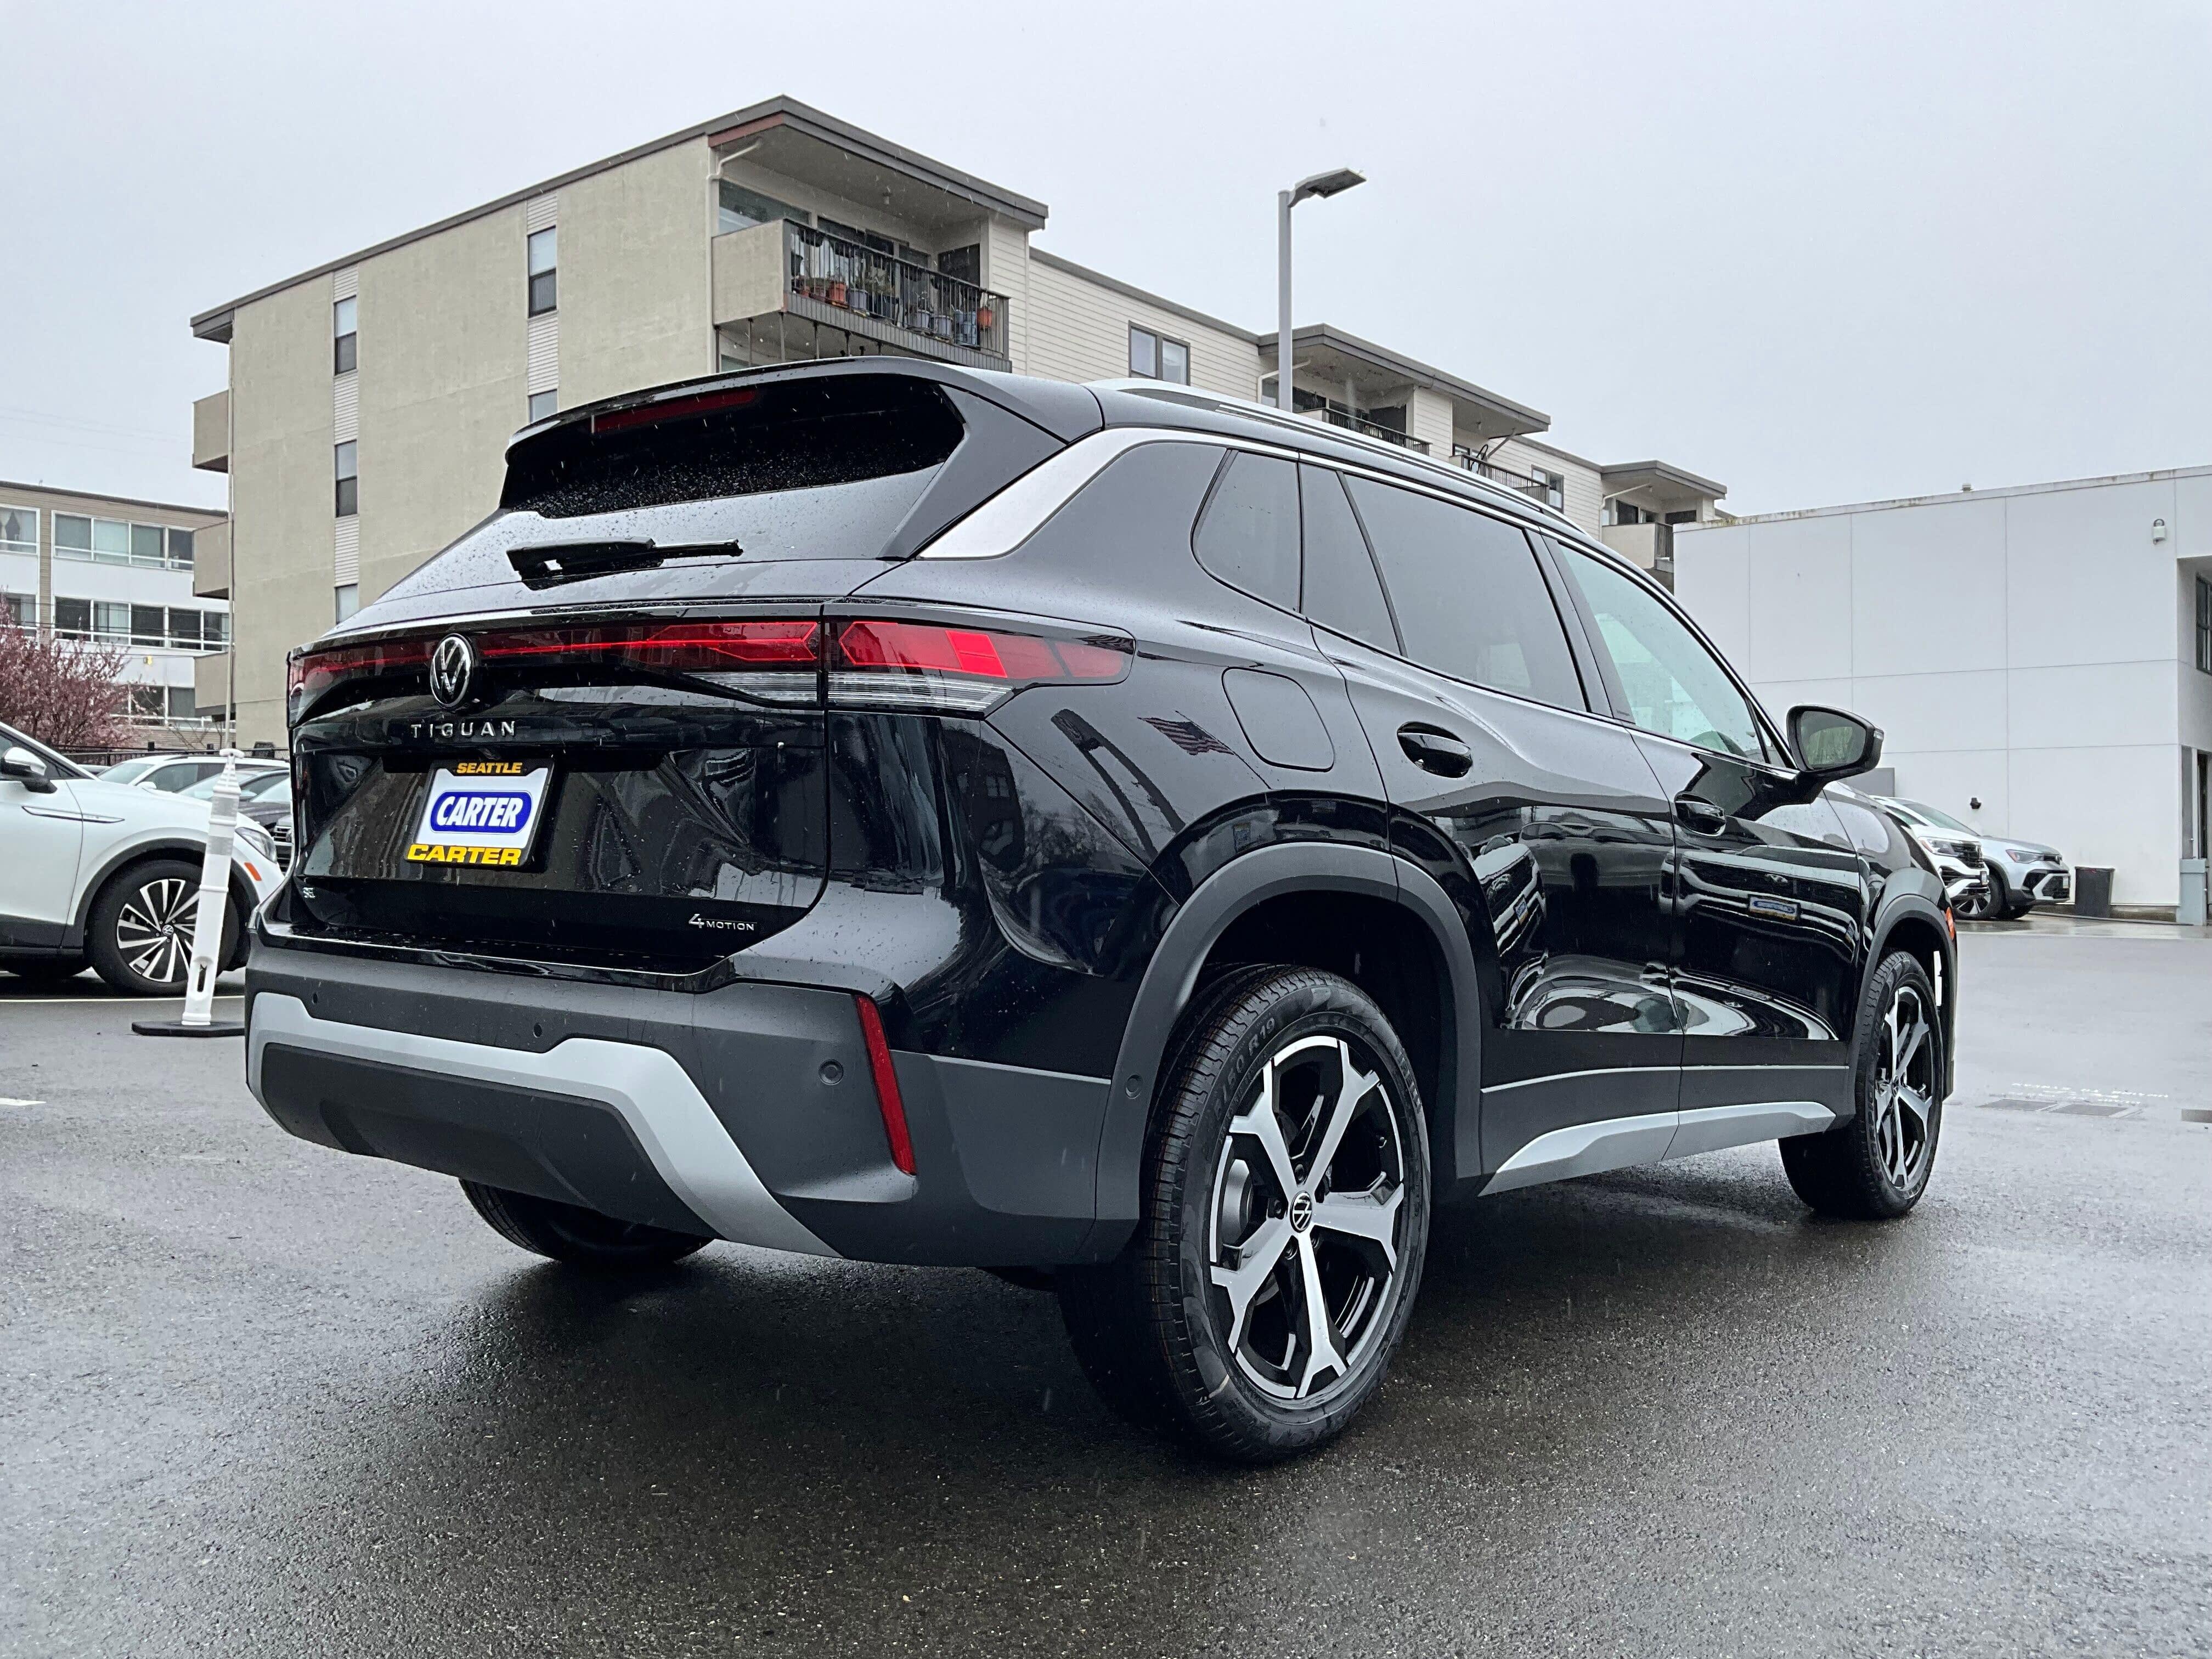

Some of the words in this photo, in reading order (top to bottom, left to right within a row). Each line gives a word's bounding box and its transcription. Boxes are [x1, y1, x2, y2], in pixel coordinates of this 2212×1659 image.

[410, 720, 515, 738] TIGUAN
[456, 762, 523, 774] SEATTLE
[437, 796, 523, 827] CARTER
[407, 844, 521, 865] CARTER
